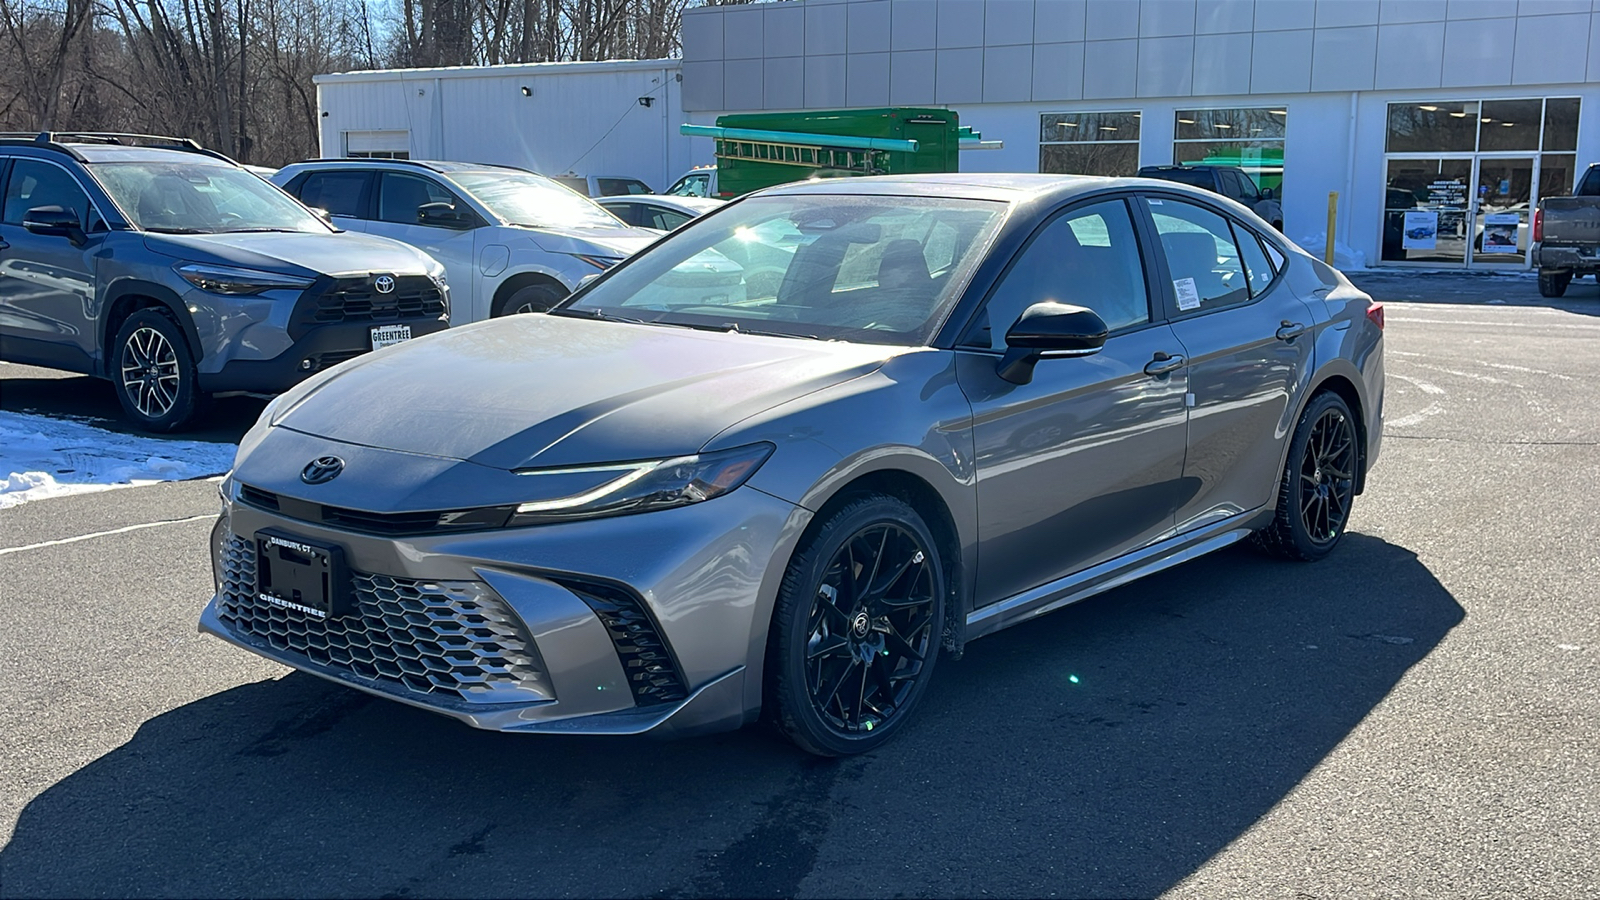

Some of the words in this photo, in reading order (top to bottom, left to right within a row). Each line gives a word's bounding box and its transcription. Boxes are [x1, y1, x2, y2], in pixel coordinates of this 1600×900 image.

[373, 330, 409, 342] GREENTREE
[270, 536, 301, 551] DANBURY,
[302, 544, 311, 553] CT
[259, 593, 326, 618] GREENTREE
